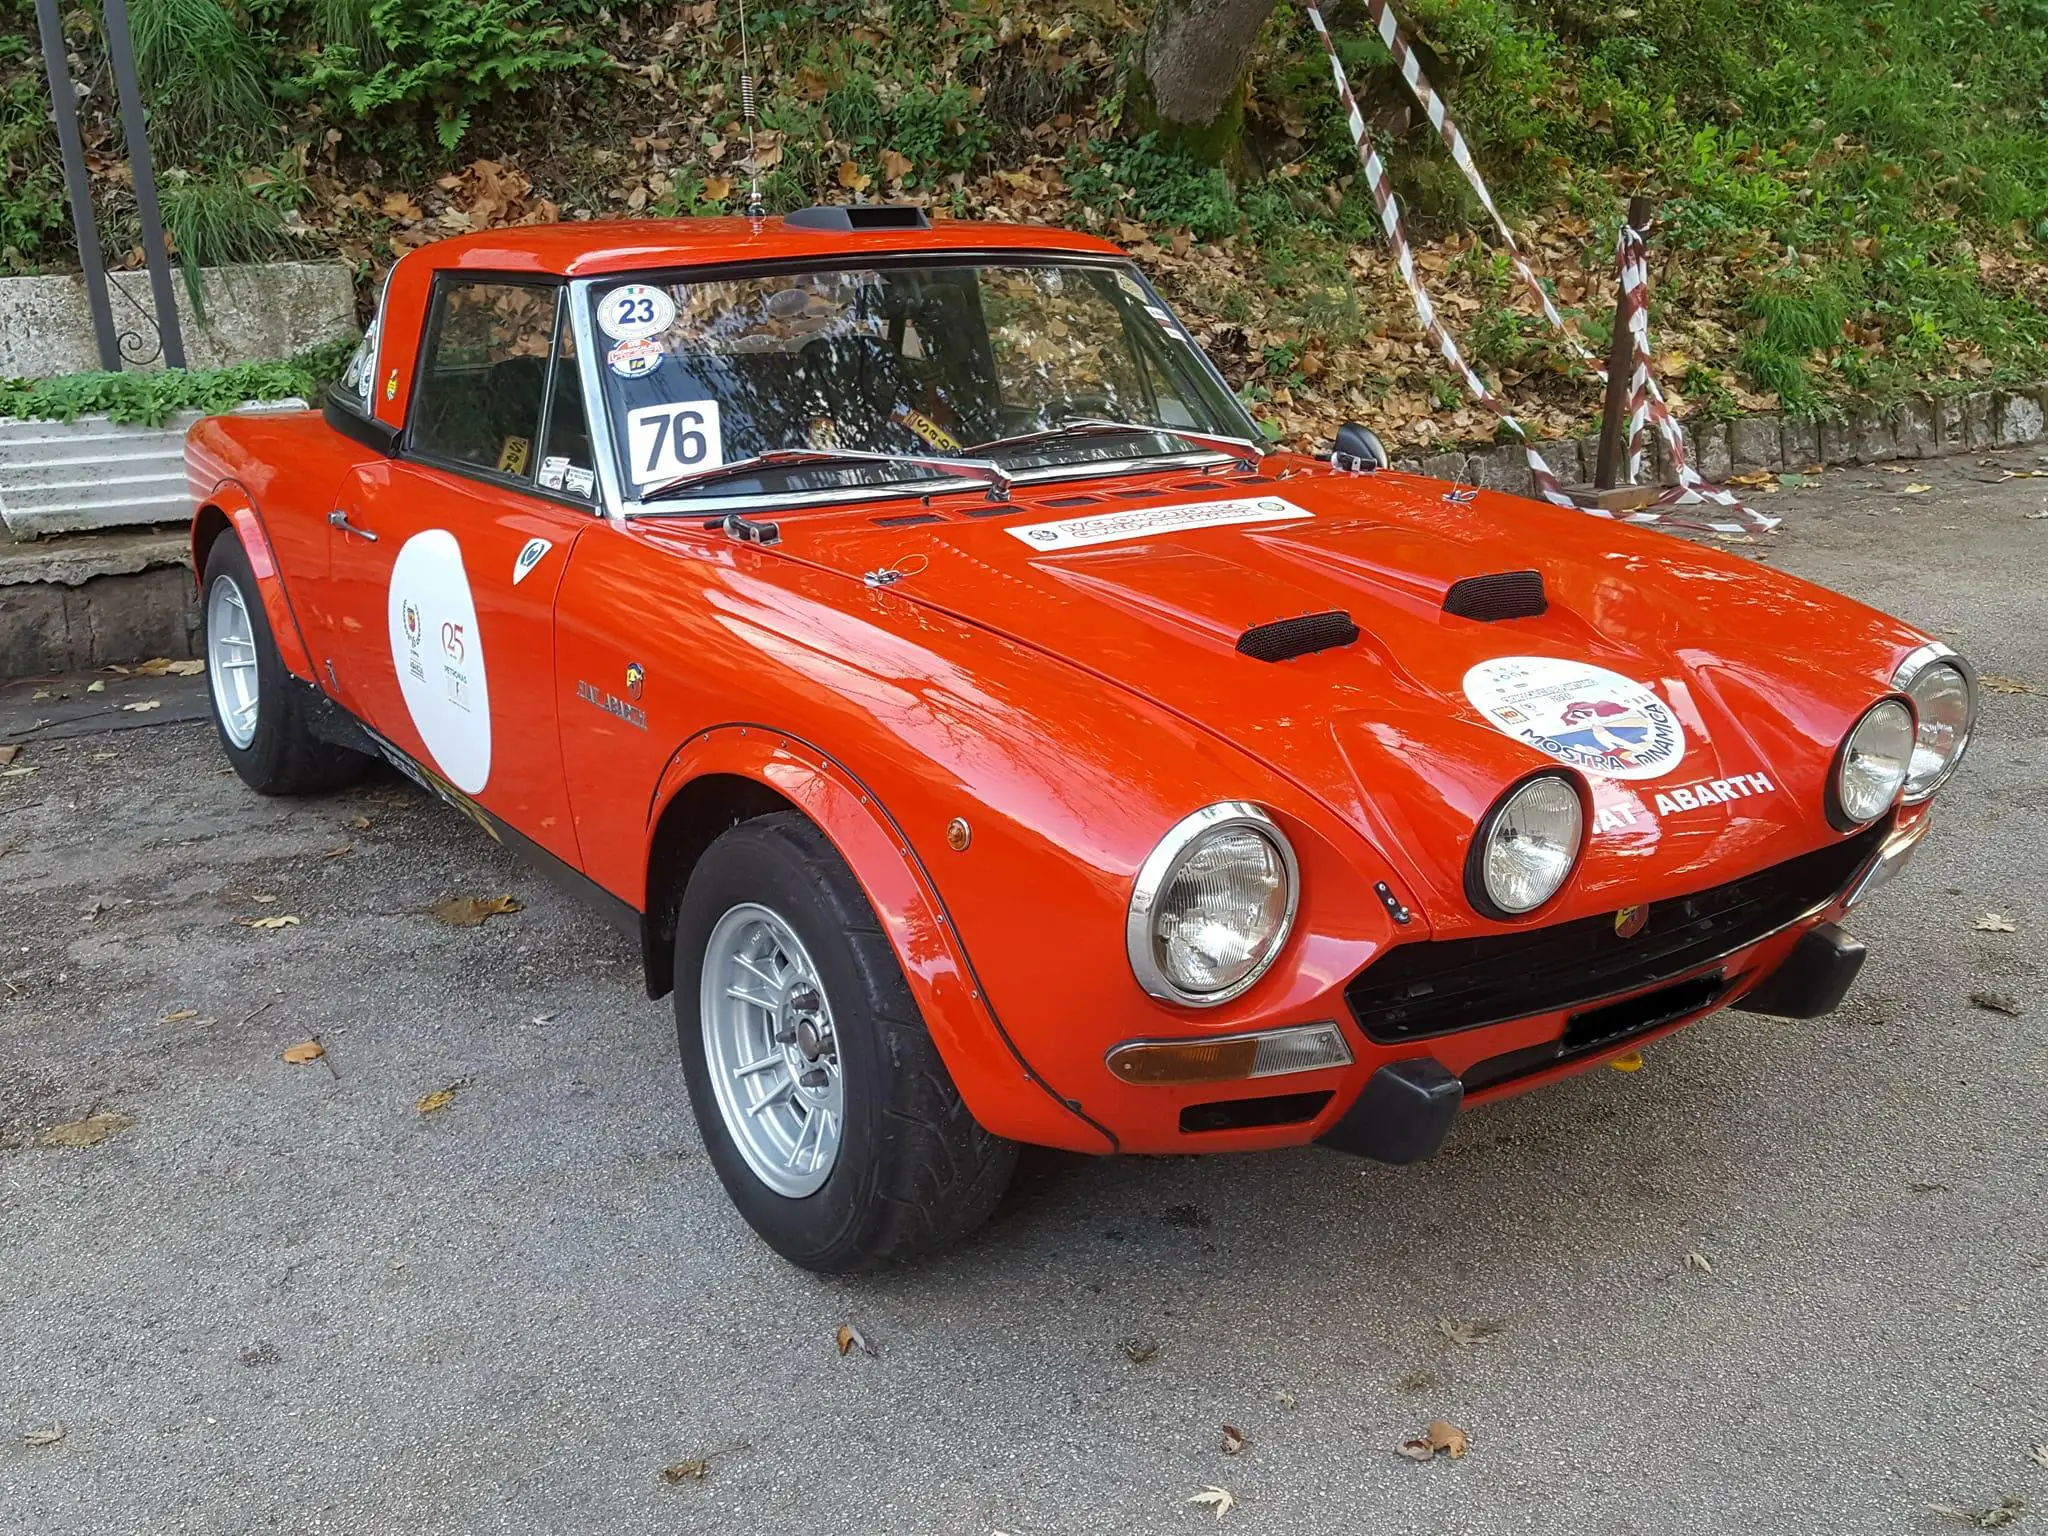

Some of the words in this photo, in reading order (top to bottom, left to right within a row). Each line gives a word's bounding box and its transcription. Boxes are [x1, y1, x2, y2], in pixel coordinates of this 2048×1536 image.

[618, 298, 655, 325] 23
[640, 410, 708, 473] 76
[1520, 728, 1627, 770] MOSTRA
[1634, 703, 1675, 767] DINAMICA
[1655, 771, 1775, 817] ABARTH
